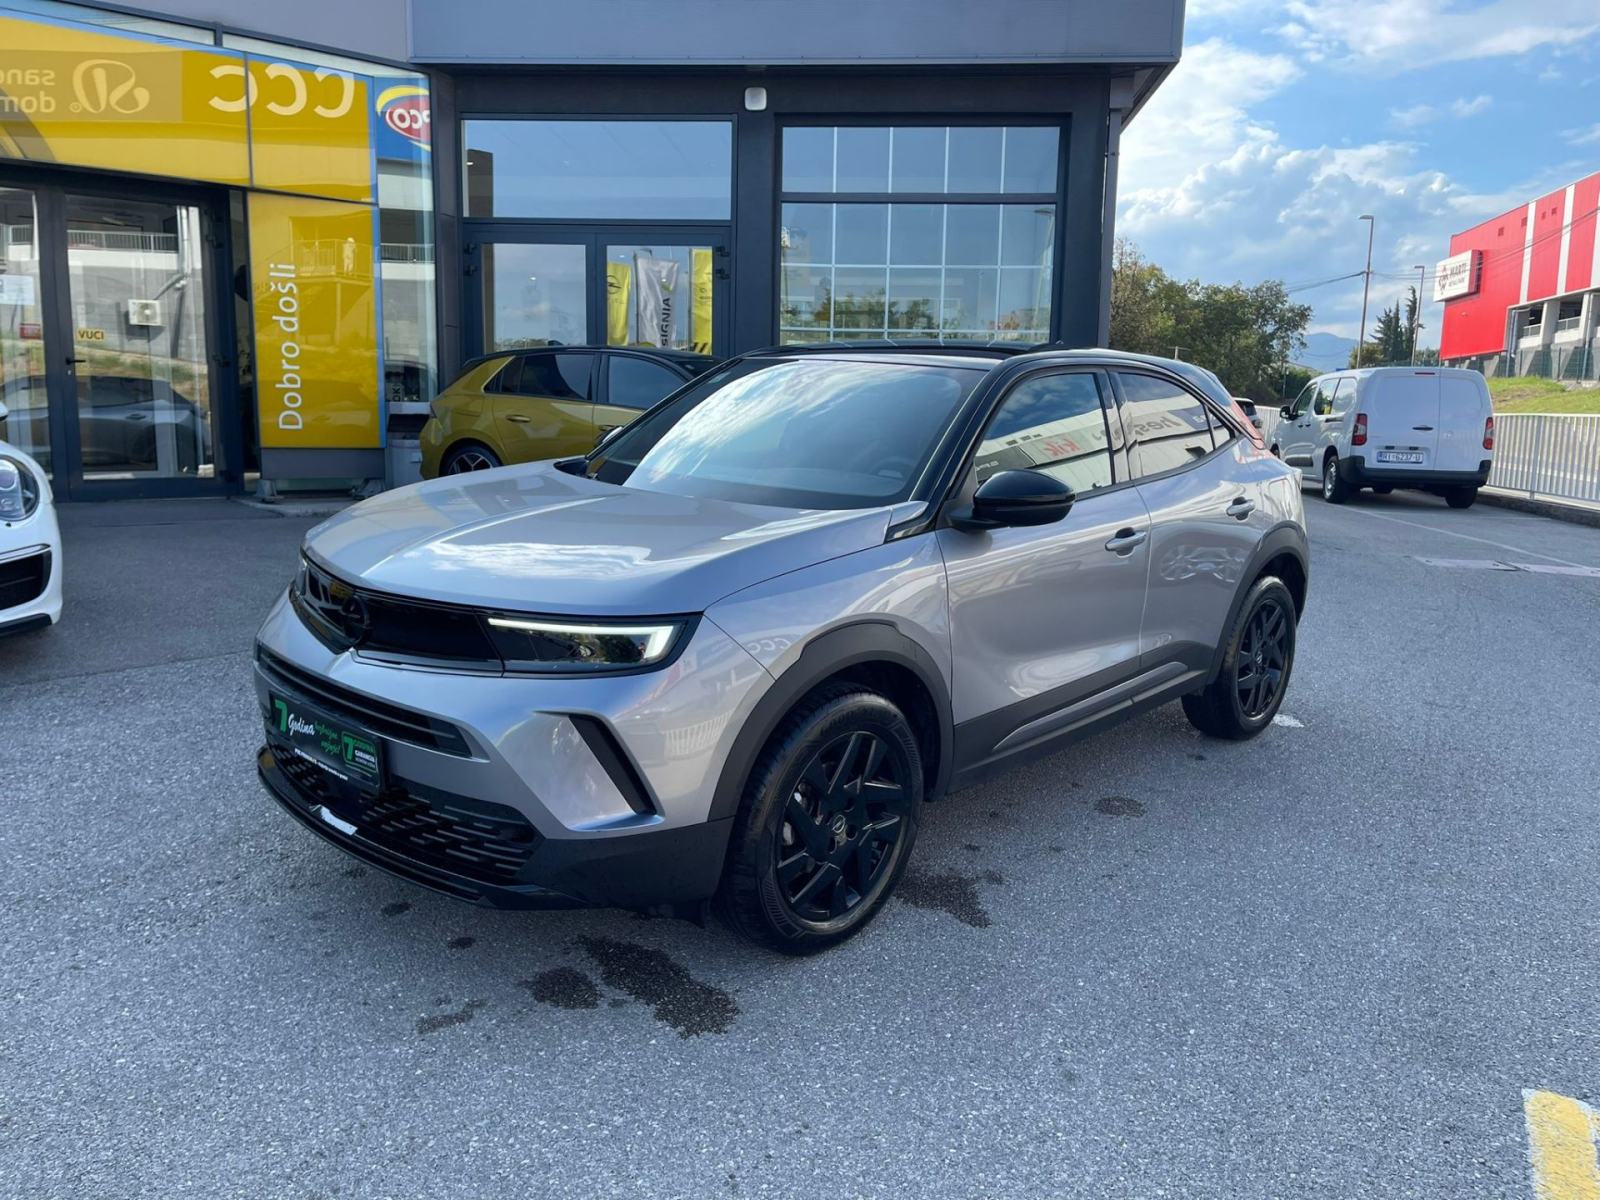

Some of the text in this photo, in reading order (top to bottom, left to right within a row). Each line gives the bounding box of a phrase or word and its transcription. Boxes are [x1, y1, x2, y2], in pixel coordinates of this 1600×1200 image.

[78, 330, 104, 340] VUCI
[269, 263, 303, 430] Dobro došli
[274, 699, 288, 733] 7
